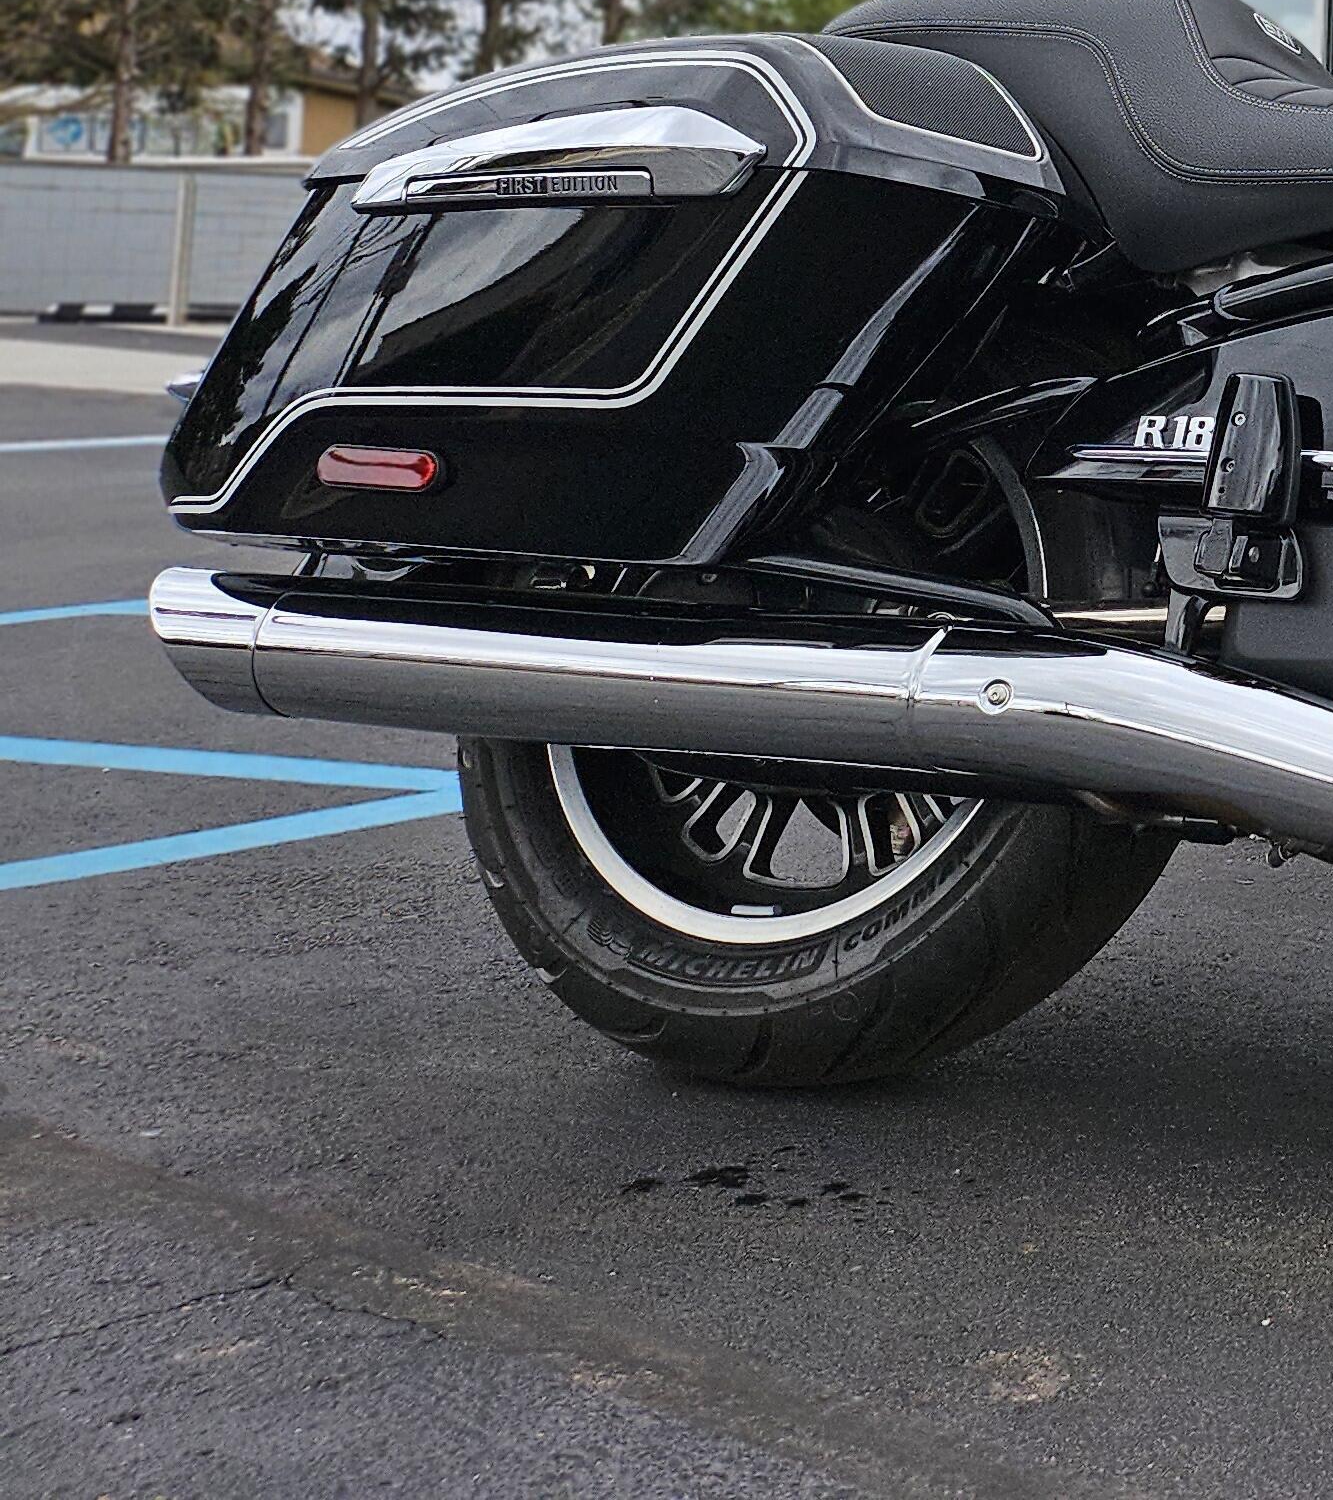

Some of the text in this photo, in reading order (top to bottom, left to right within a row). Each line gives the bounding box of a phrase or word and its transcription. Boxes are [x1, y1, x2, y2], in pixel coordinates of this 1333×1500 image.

[499, 175, 619, 196] FIRST EDITION
[637, 946, 820, 980] MICHELIN
